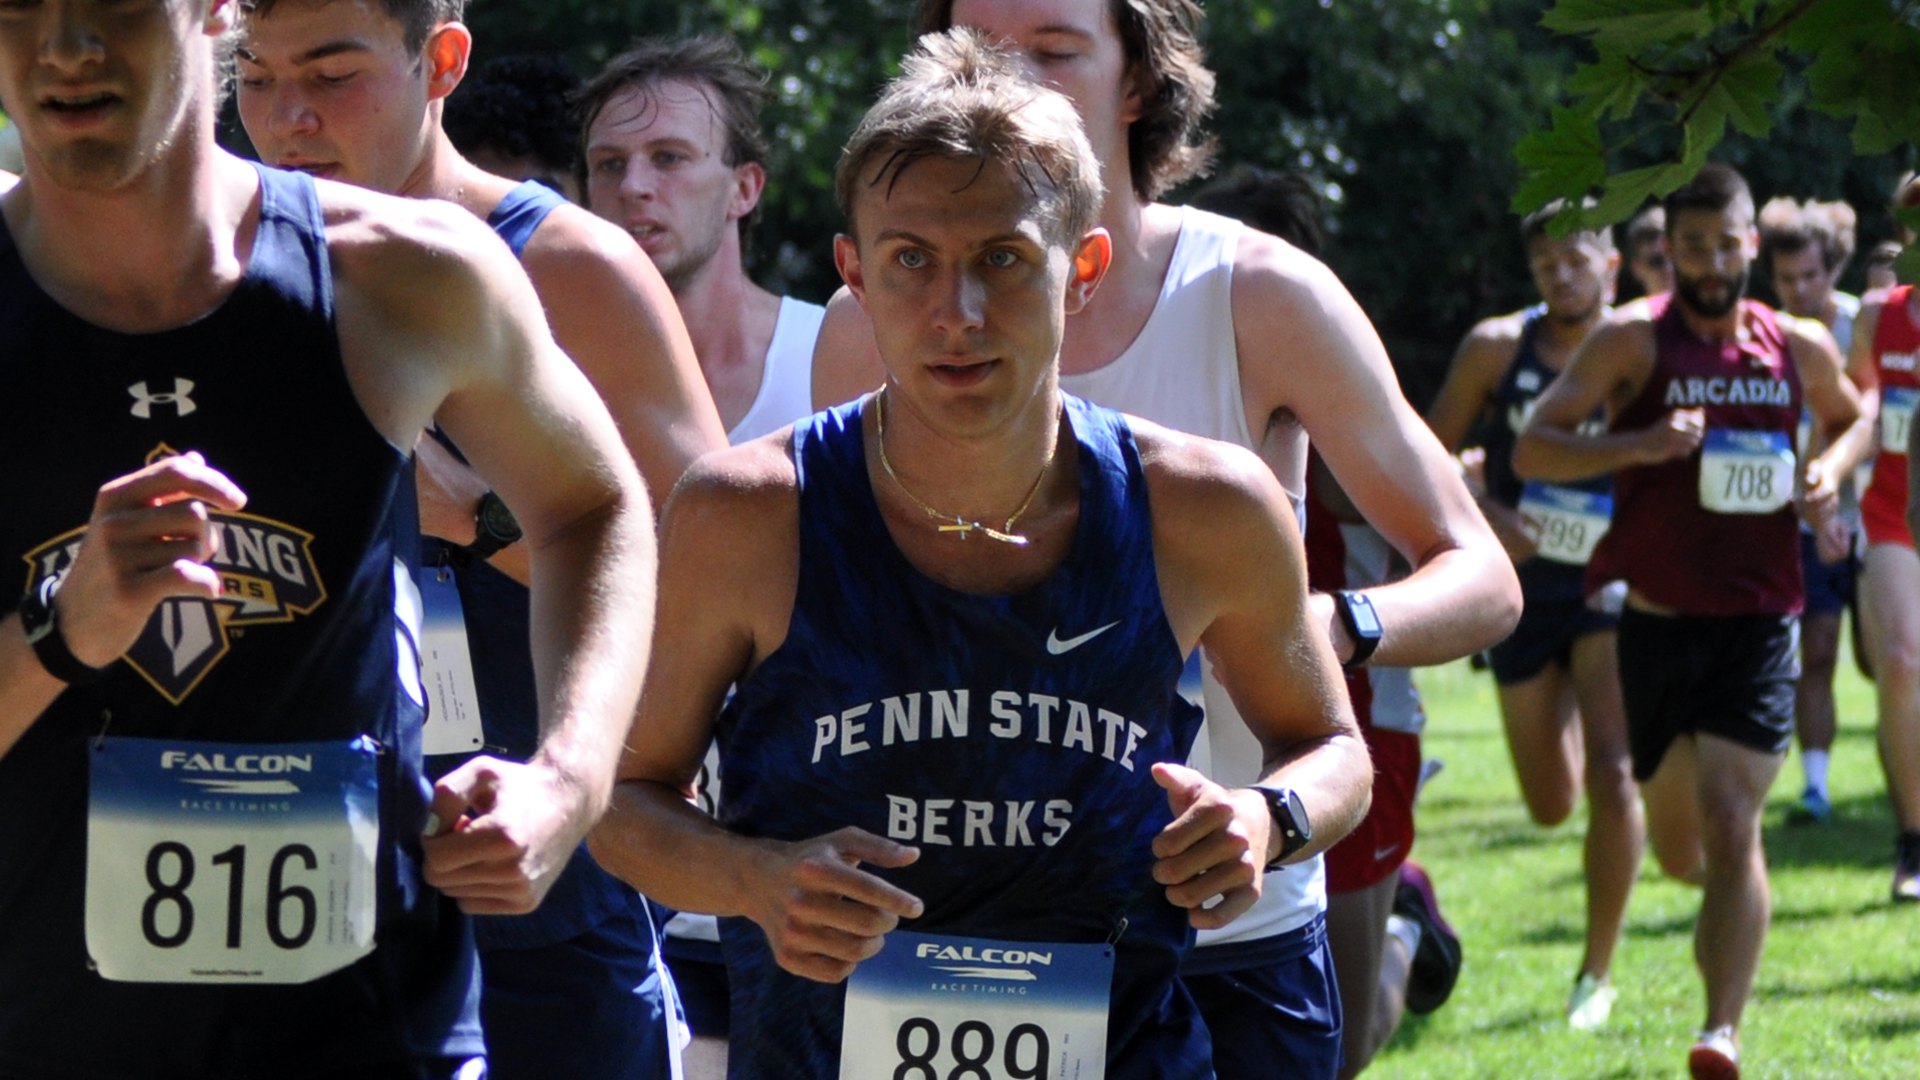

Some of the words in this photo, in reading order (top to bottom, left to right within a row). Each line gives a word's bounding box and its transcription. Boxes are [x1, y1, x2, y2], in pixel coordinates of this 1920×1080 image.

[1664, 376, 1791, 406] ARCADIA
[1723, 464, 1773, 501] 708
[1542, 514, 1586, 553] 99
[811, 689, 970, 764] PENN
[989, 690, 1147, 772] STATE
[161, 751, 312, 773] FALCON
[180, 800, 223, 811] RACE
[229, 801, 291, 811] TIMING
[886, 794, 1073, 847] BERKS
[141, 840, 318, 949] 816
[916, 942, 1052, 965] FALCON
[931, 982, 967, 992] RACE
[973, 984, 1028, 995] TIMING
[892, 1017, 1050, 1080] 889
